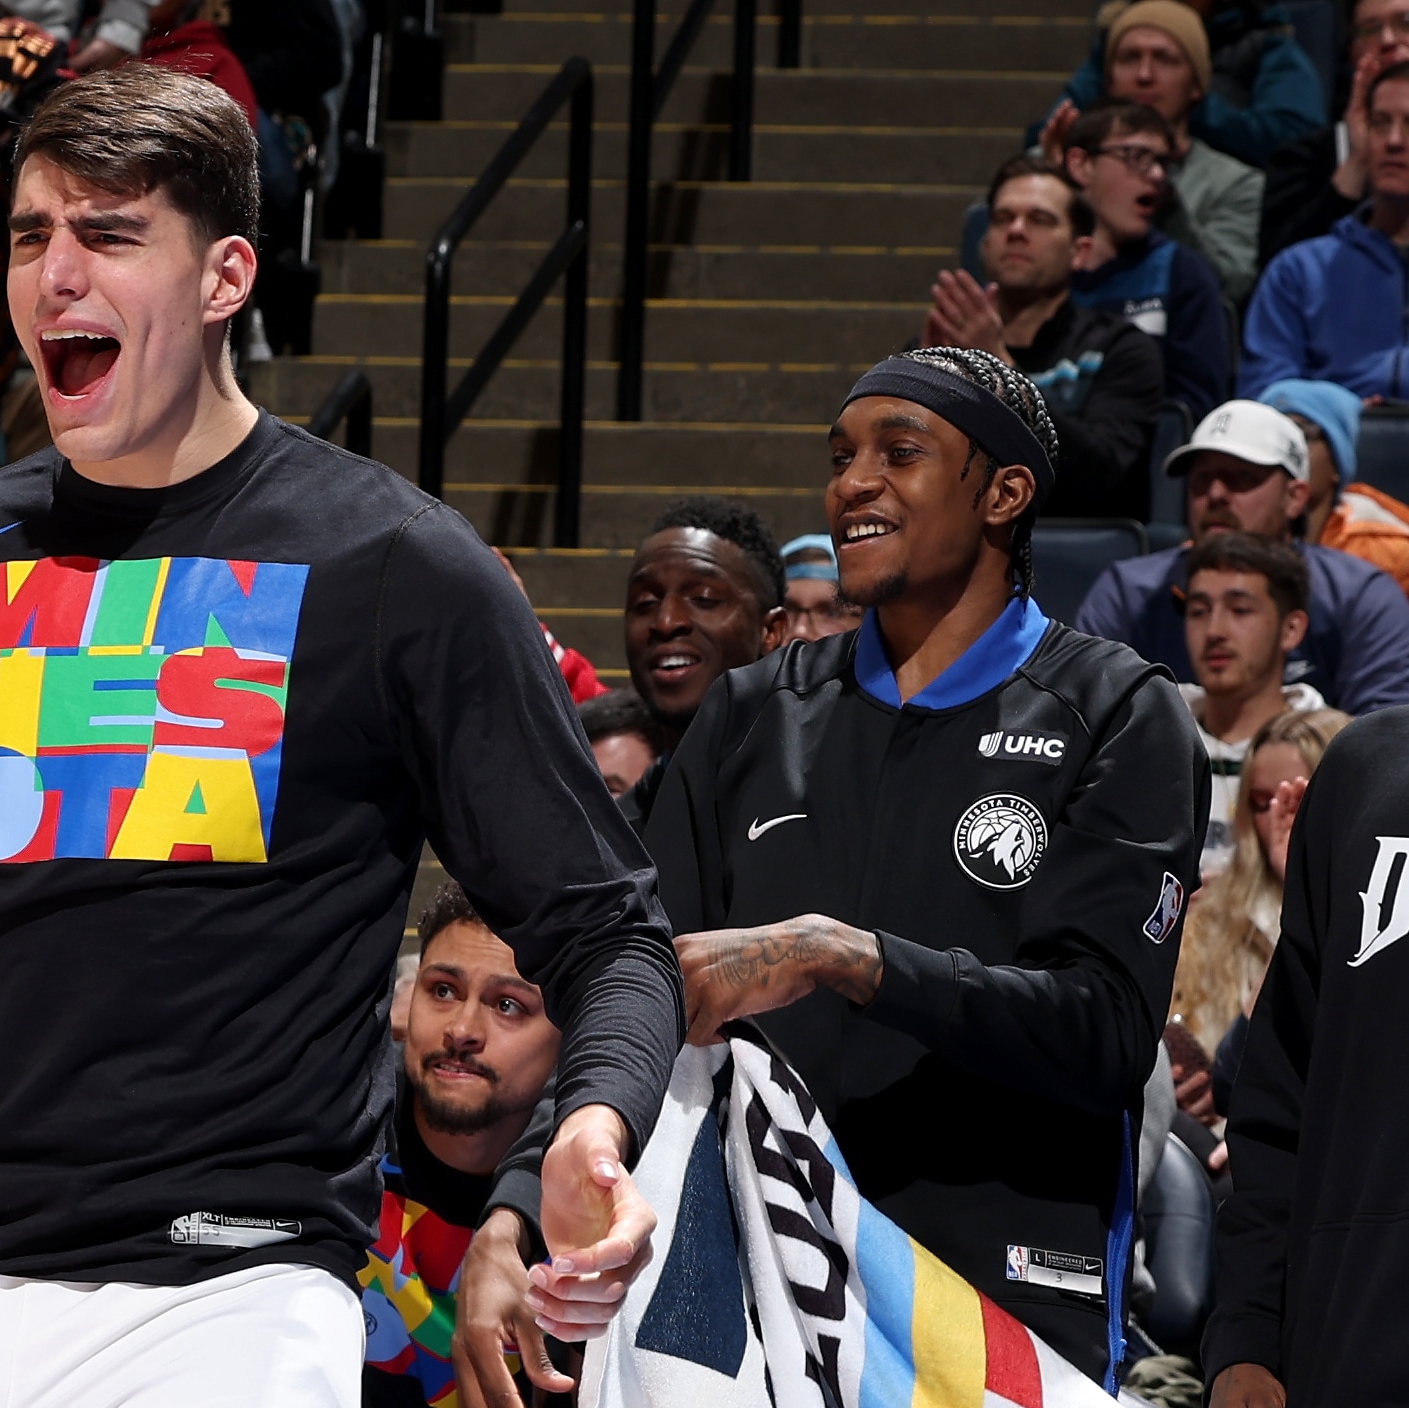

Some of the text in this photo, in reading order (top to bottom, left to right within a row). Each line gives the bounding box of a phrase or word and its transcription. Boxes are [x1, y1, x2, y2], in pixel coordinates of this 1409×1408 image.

[1004, 735, 1065, 758] UHC
[957, 799, 1044, 877] MINNESOTA TIMBERWOLVES
[202, 1211, 221, 1222] XLT
